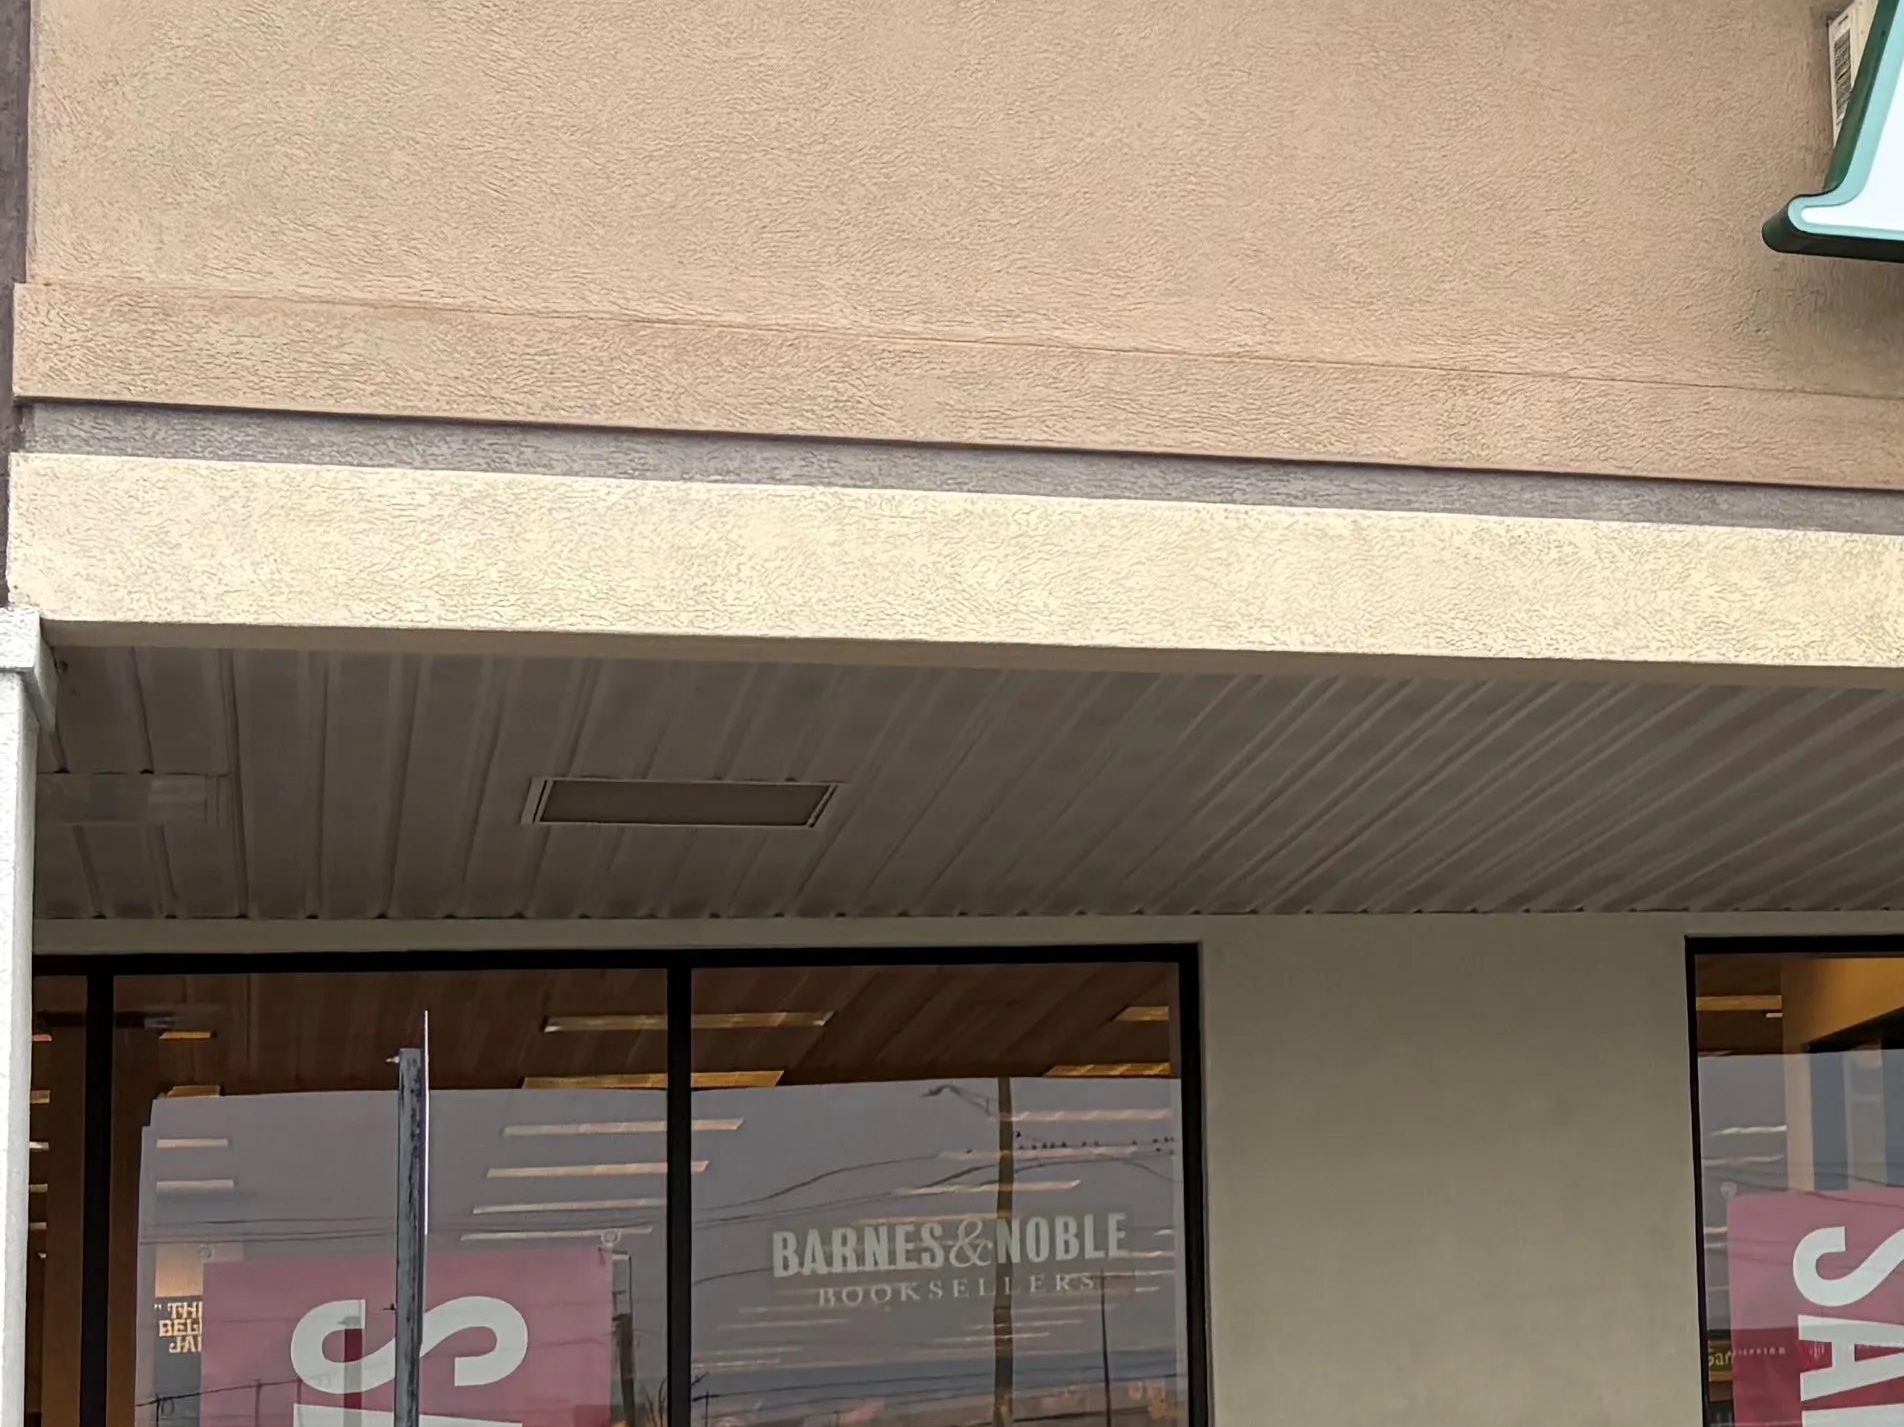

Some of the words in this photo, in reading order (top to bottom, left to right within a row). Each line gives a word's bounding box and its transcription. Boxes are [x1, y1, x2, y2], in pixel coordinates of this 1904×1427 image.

[773, 1223, 944, 1278] BARNES
[996, 1213, 1128, 1264] NOBLE
[818, 1273, 1096, 1308] BOOKSELLERS
